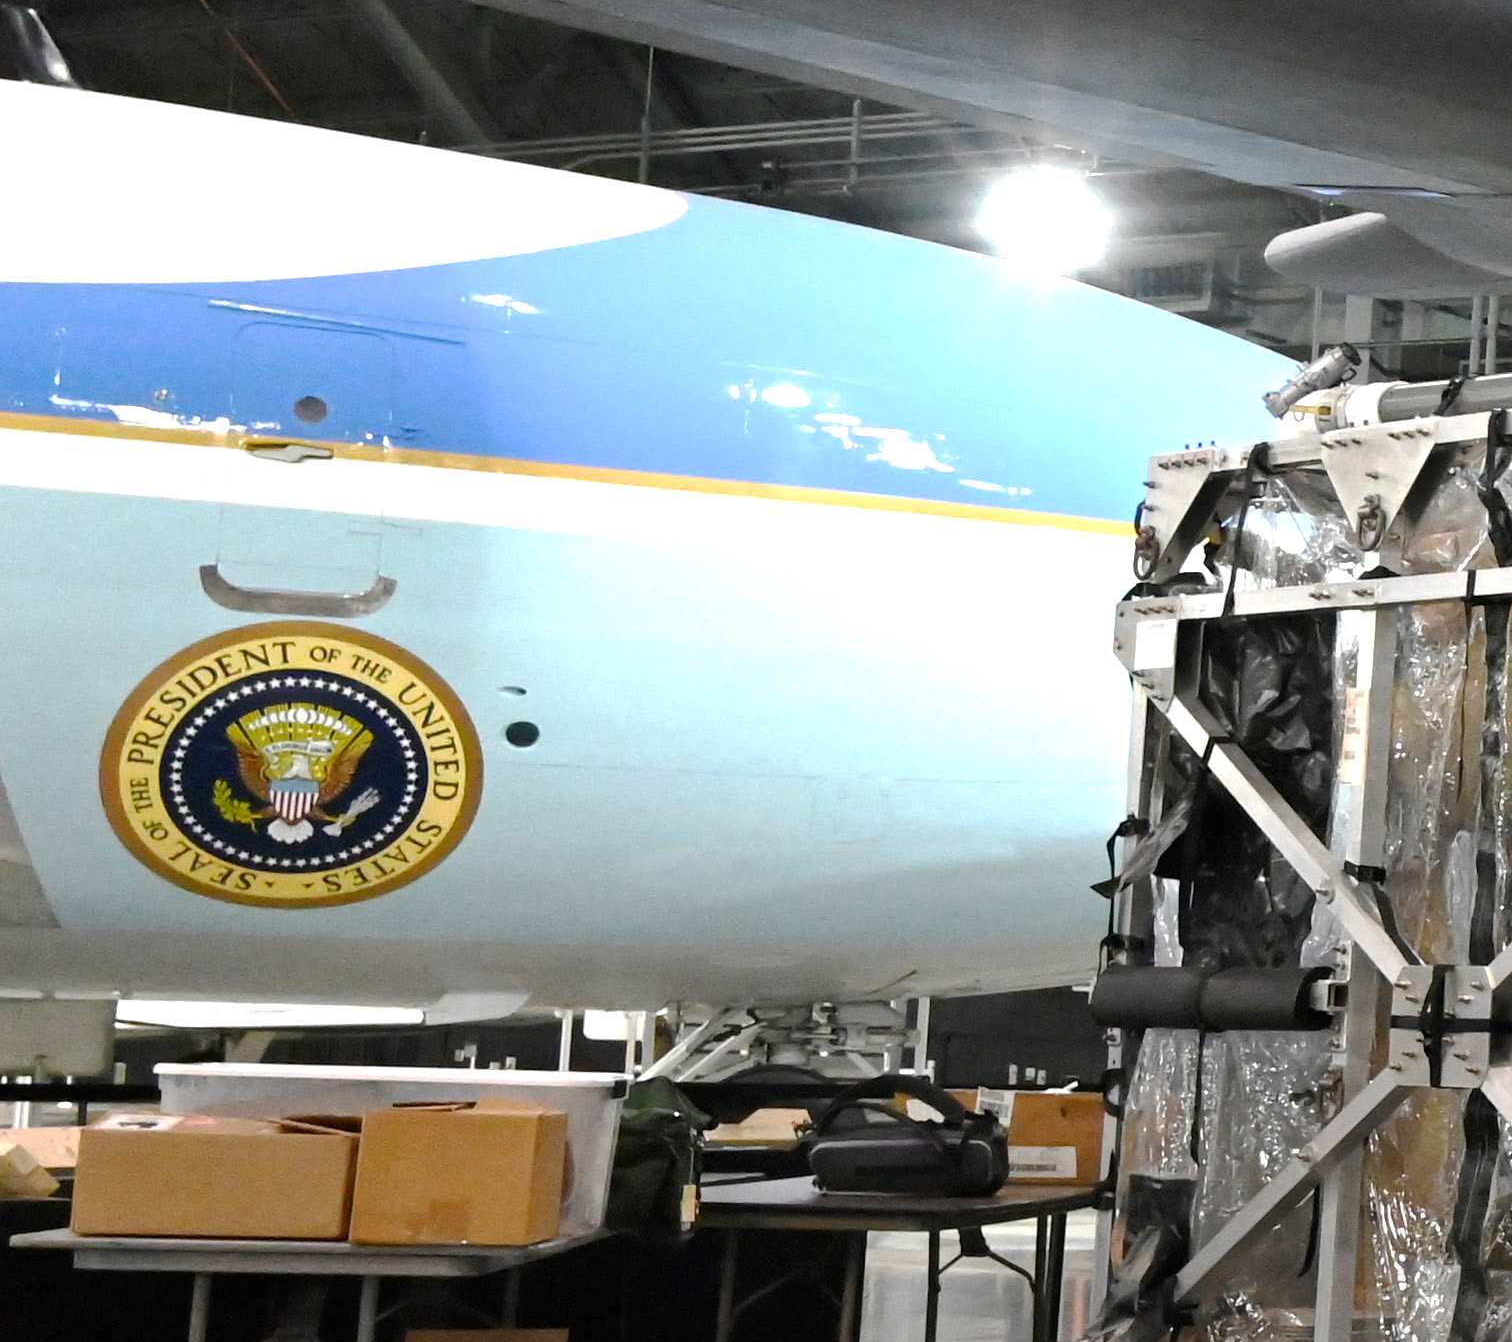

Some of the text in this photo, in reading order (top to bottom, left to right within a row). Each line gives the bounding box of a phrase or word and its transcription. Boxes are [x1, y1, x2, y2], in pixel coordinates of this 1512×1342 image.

[127, 641, 460, 893] SEAL OF THE PRESIDENT OF THE UNITED STATES
